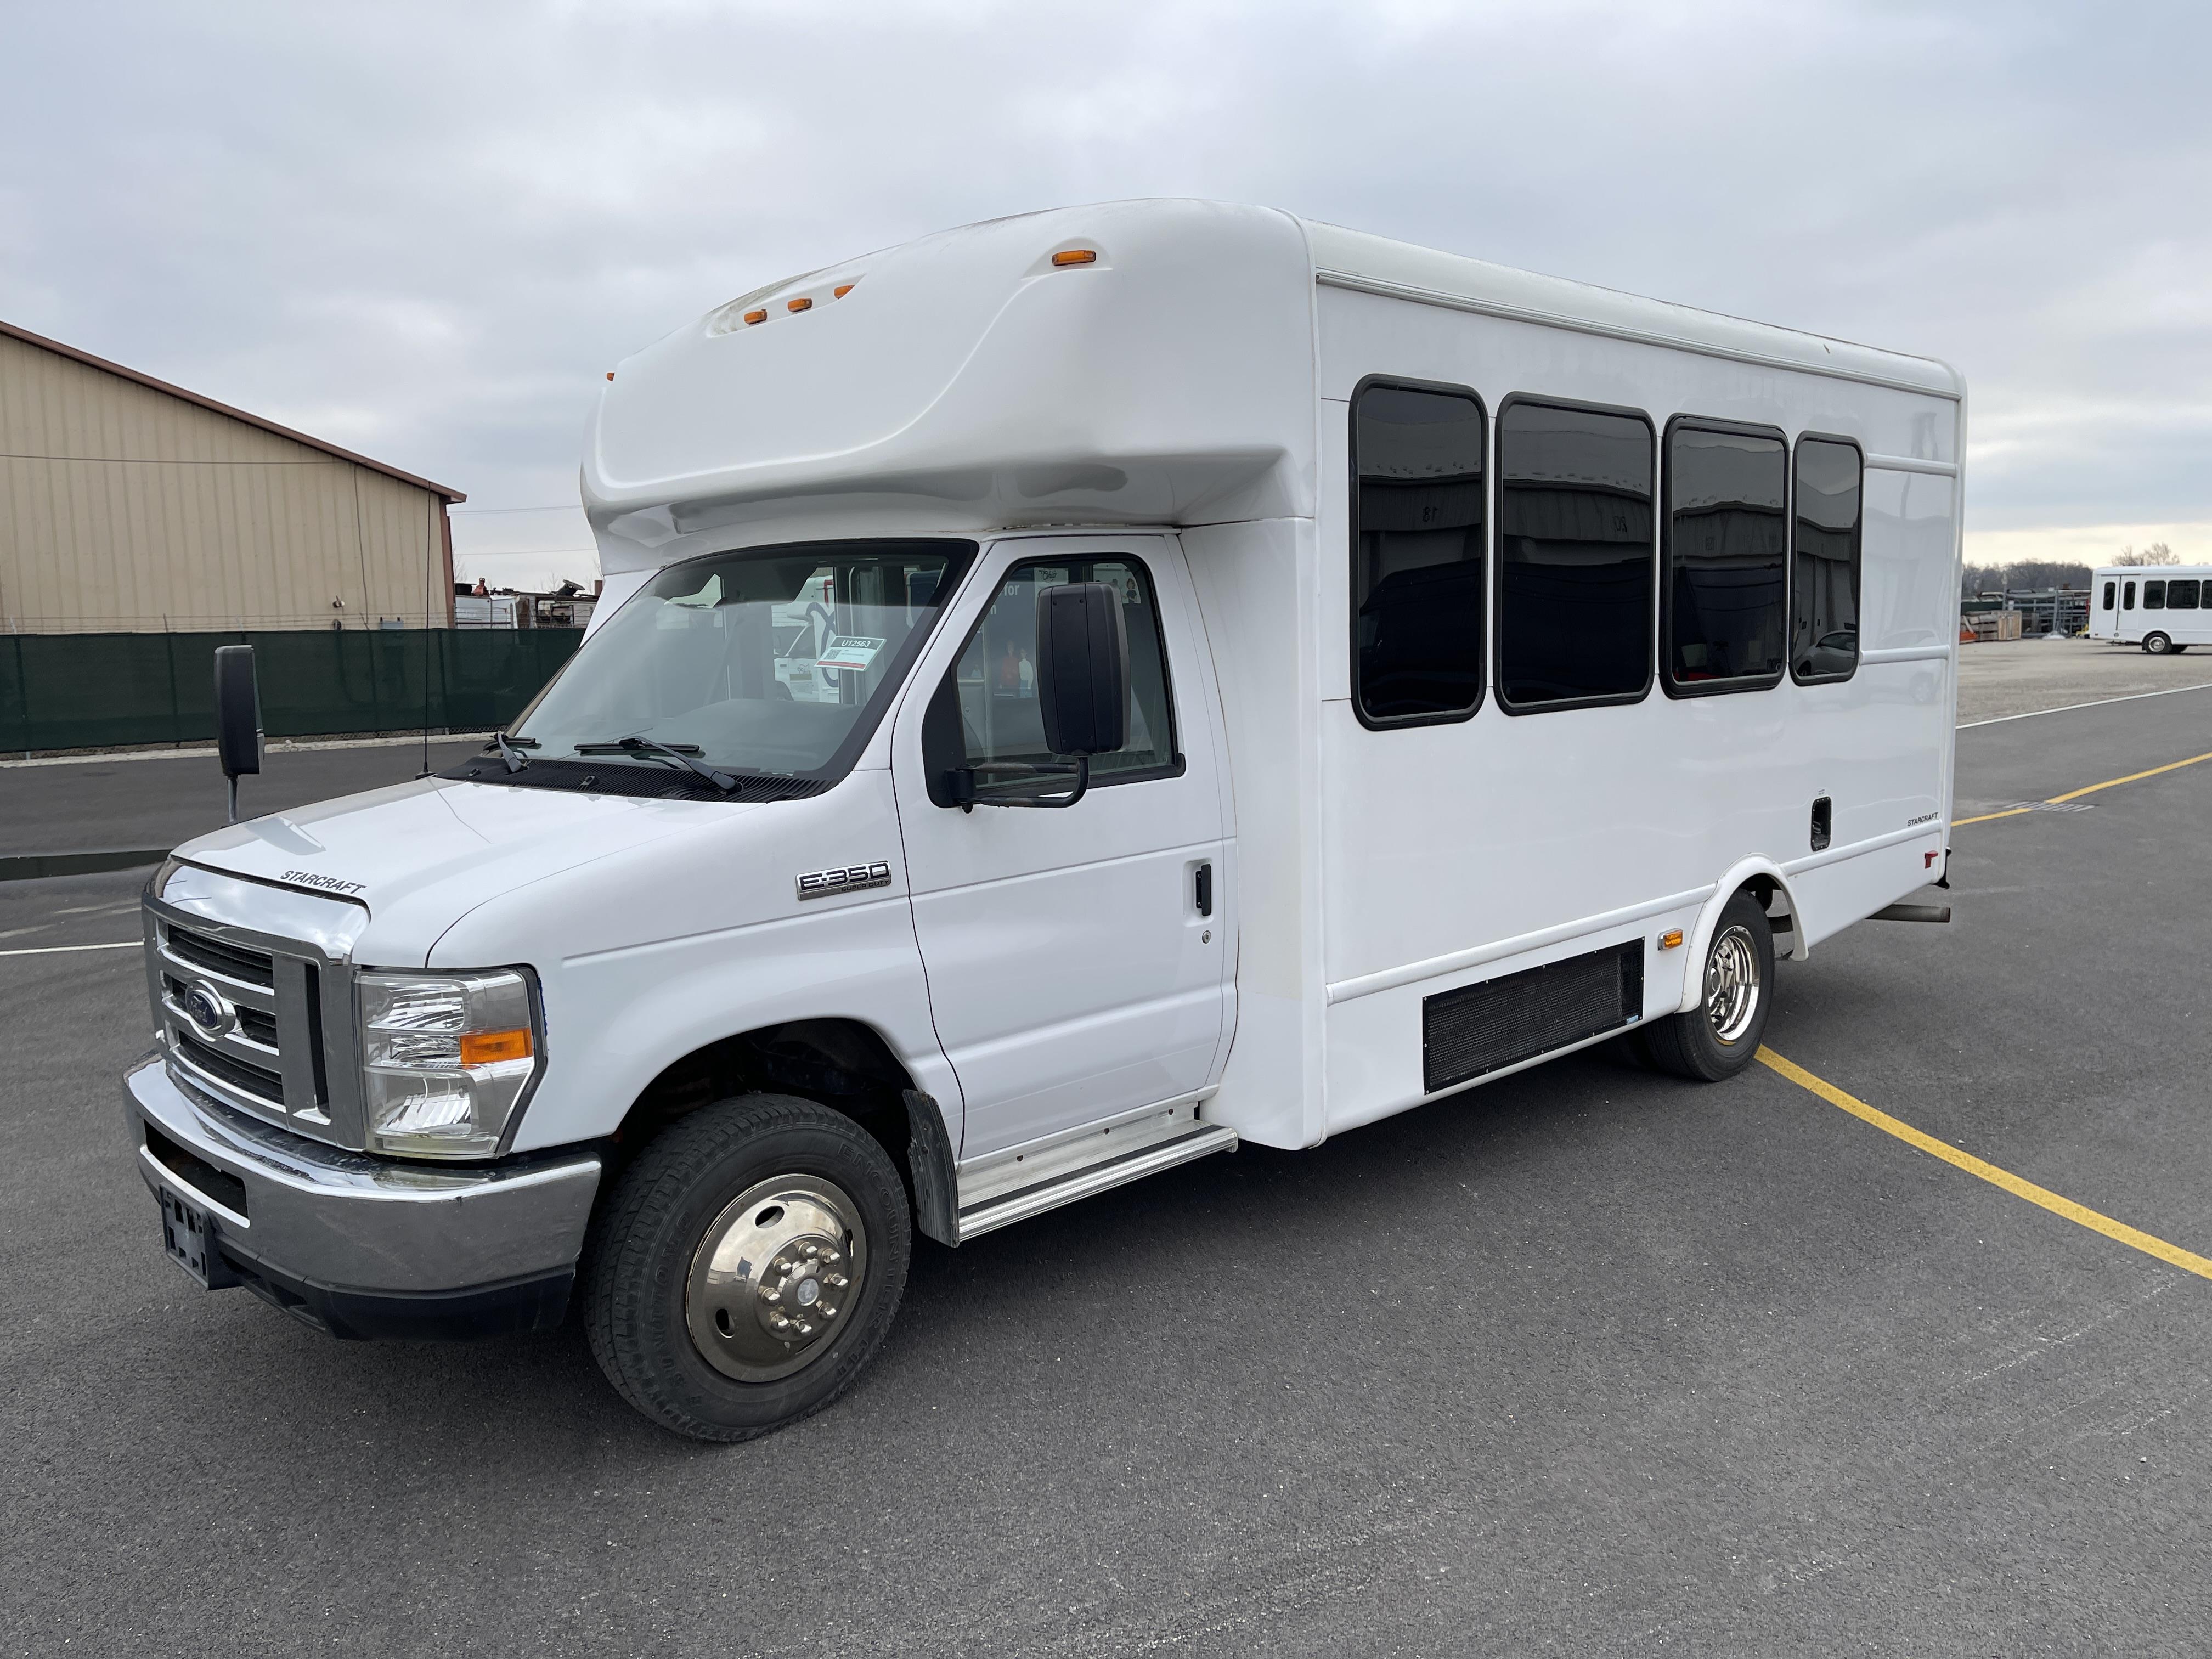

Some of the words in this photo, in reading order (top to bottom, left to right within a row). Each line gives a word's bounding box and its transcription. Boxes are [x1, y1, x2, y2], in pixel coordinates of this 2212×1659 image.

[1907, 812, 1939, 826] STARCRAFT
[280, 870, 367, 894] STARCRAFT
[800, 862, 889, 890] E-350
[840, 884, 867, 893] SUPER
[868, 879, 889, 888] DUTY
